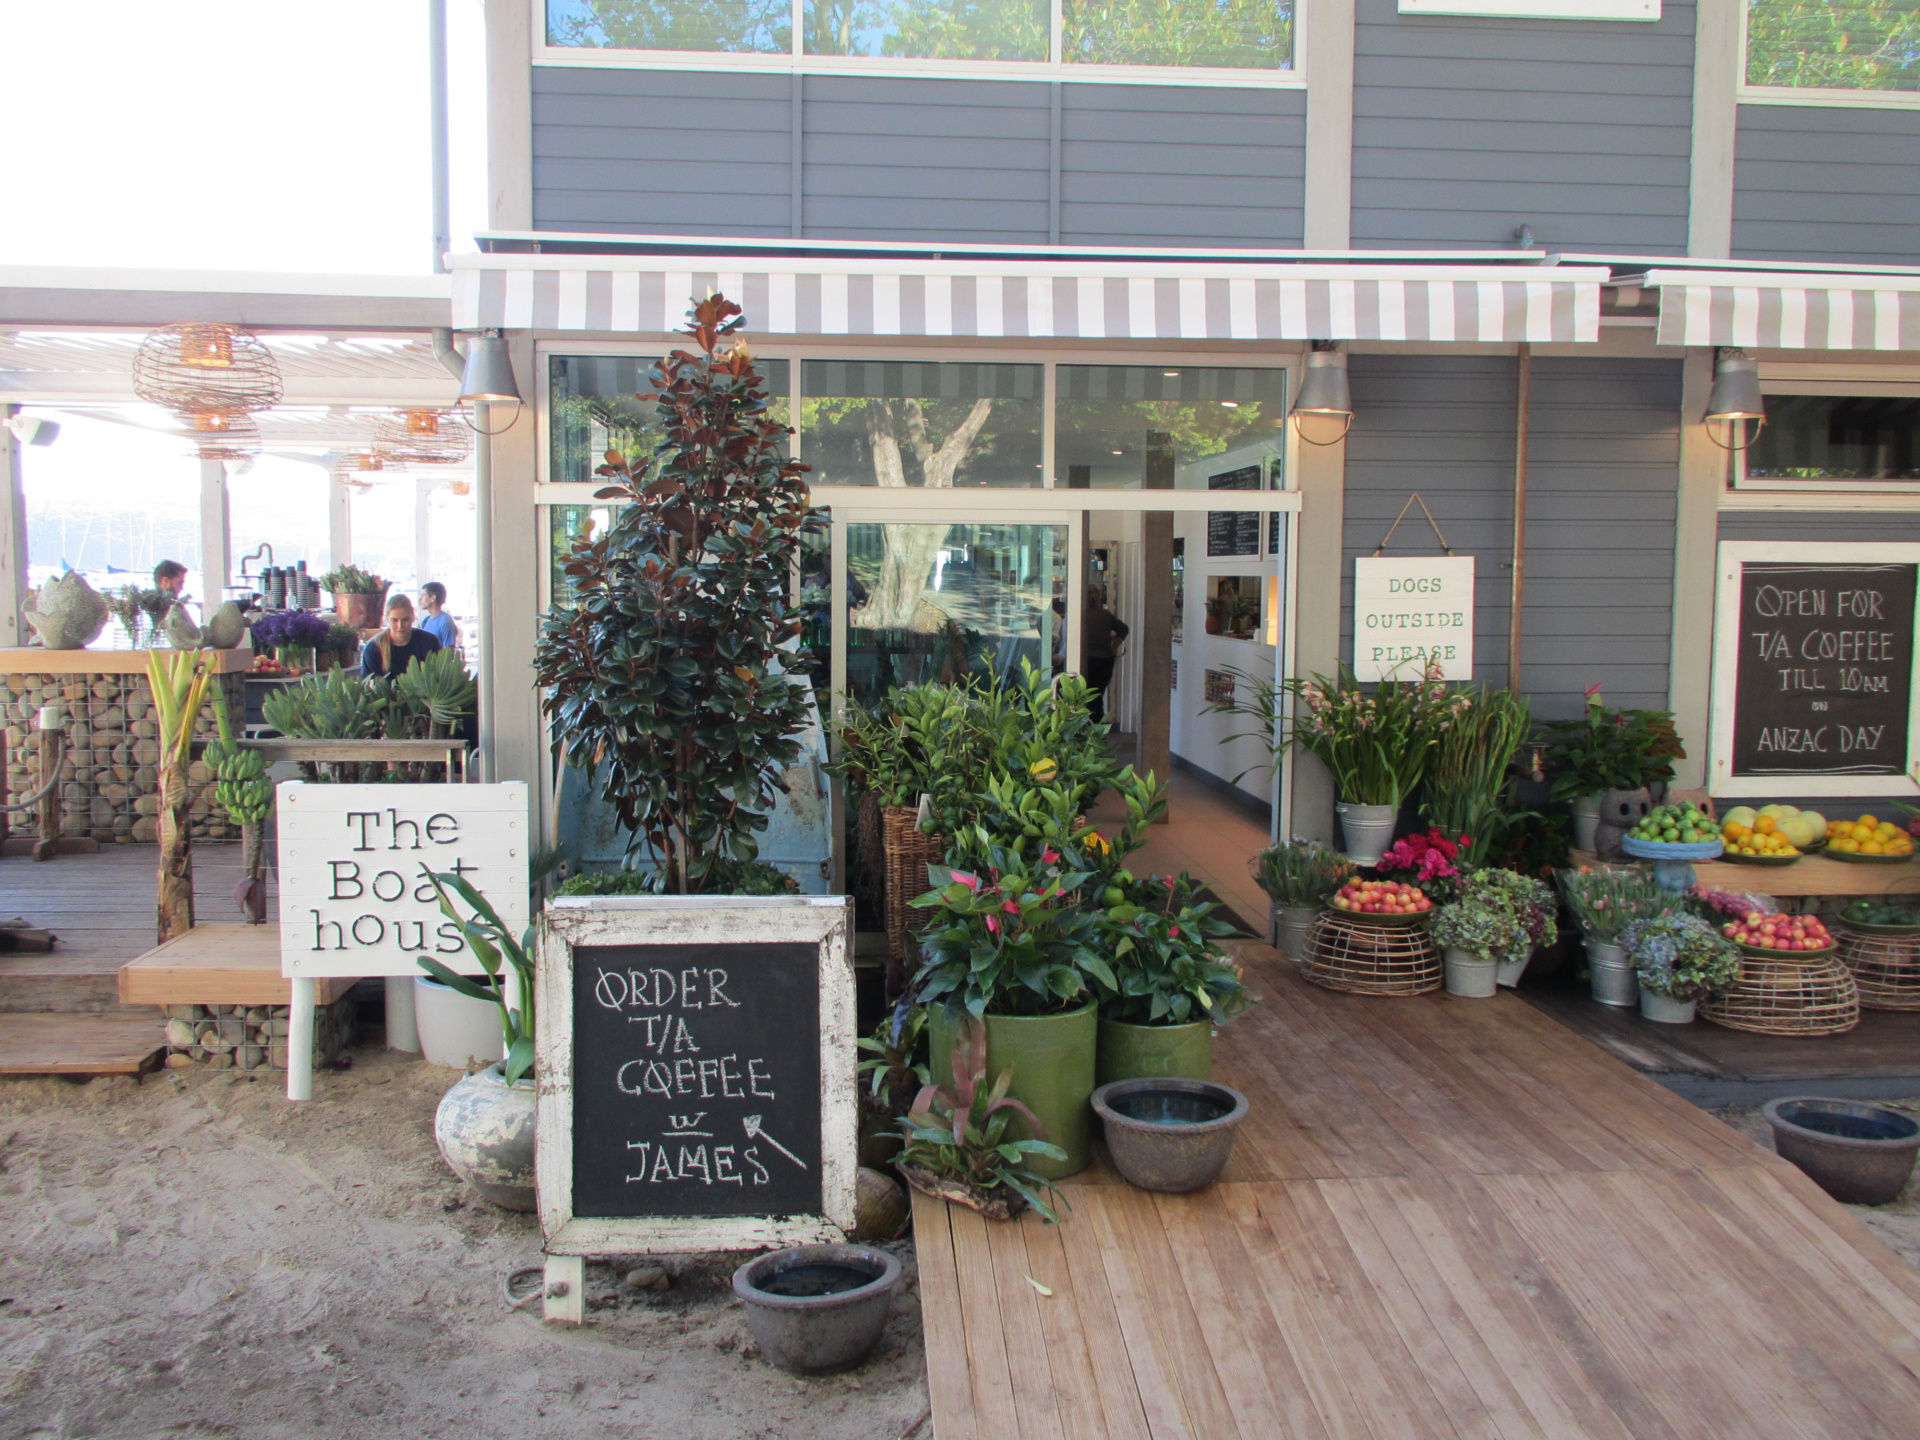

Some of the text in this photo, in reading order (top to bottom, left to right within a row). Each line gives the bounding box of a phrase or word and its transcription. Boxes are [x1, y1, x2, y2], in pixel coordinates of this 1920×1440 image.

[1389, 577, 1442, 593] DOGS
[1366, 612, 1464, 628] OUTSIDE
[1372, 645, 1456, 661] PLEASE
[1752, 630, 1793, 662] T/A
[1778, 668, 1826, 691] TILL
[1757, 725, 1886, 753] ANZAC DAY
[346, 808, 458, 851] The
[628, 1014, 701, 1055] T/A
[626, 1140, 770, 1186] JAMES
